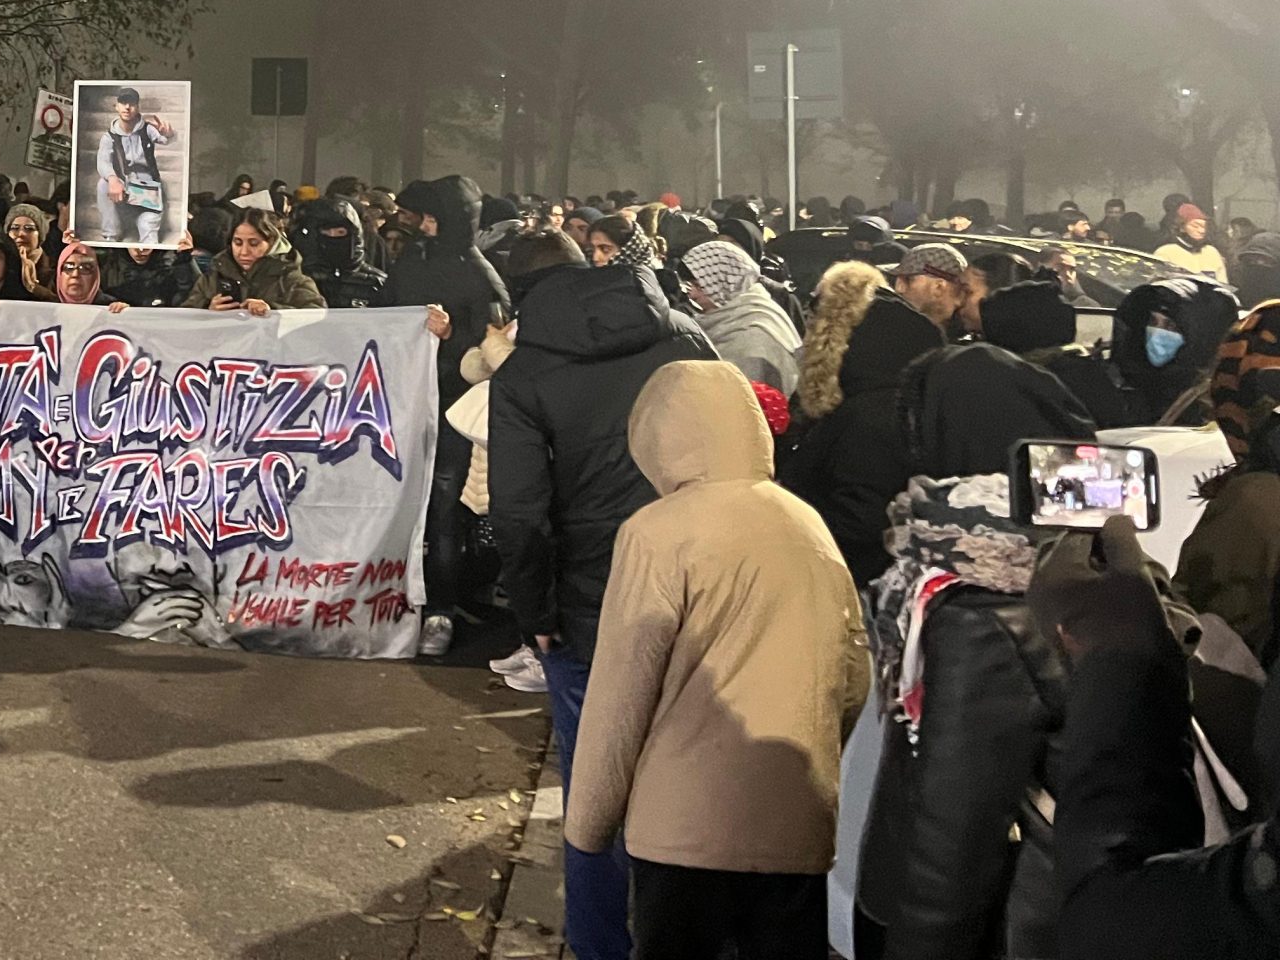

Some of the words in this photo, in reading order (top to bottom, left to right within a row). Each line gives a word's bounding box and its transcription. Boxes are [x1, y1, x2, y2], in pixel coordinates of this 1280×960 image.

[53, 394, 71, 423] E
[57, 486, 85, 522] E
[74, 451, 305, 554] FARES
[236, 552, 268, 588] LA
[275, 556, 360, 591] MORTE
[357, 556, 407, 587] NON
[312, 598, 357, 631] PER
